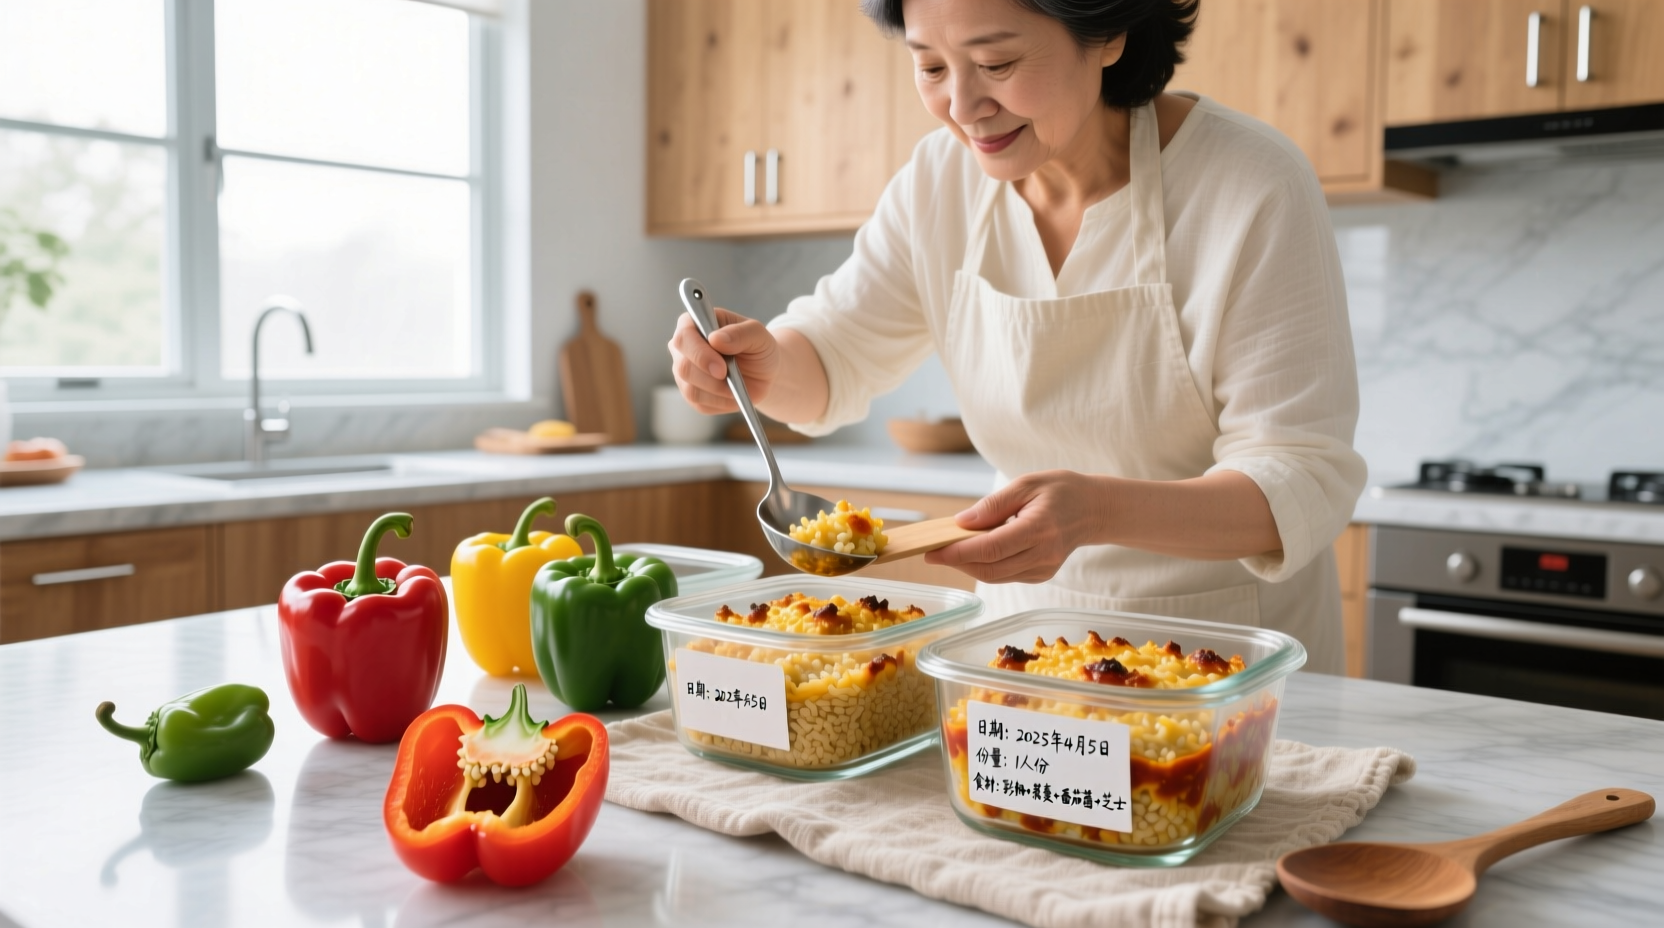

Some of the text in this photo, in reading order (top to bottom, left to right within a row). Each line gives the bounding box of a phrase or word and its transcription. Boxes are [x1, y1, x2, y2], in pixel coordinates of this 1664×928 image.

[978, 718, 1109, 757] 日期: 2025年4月5日
